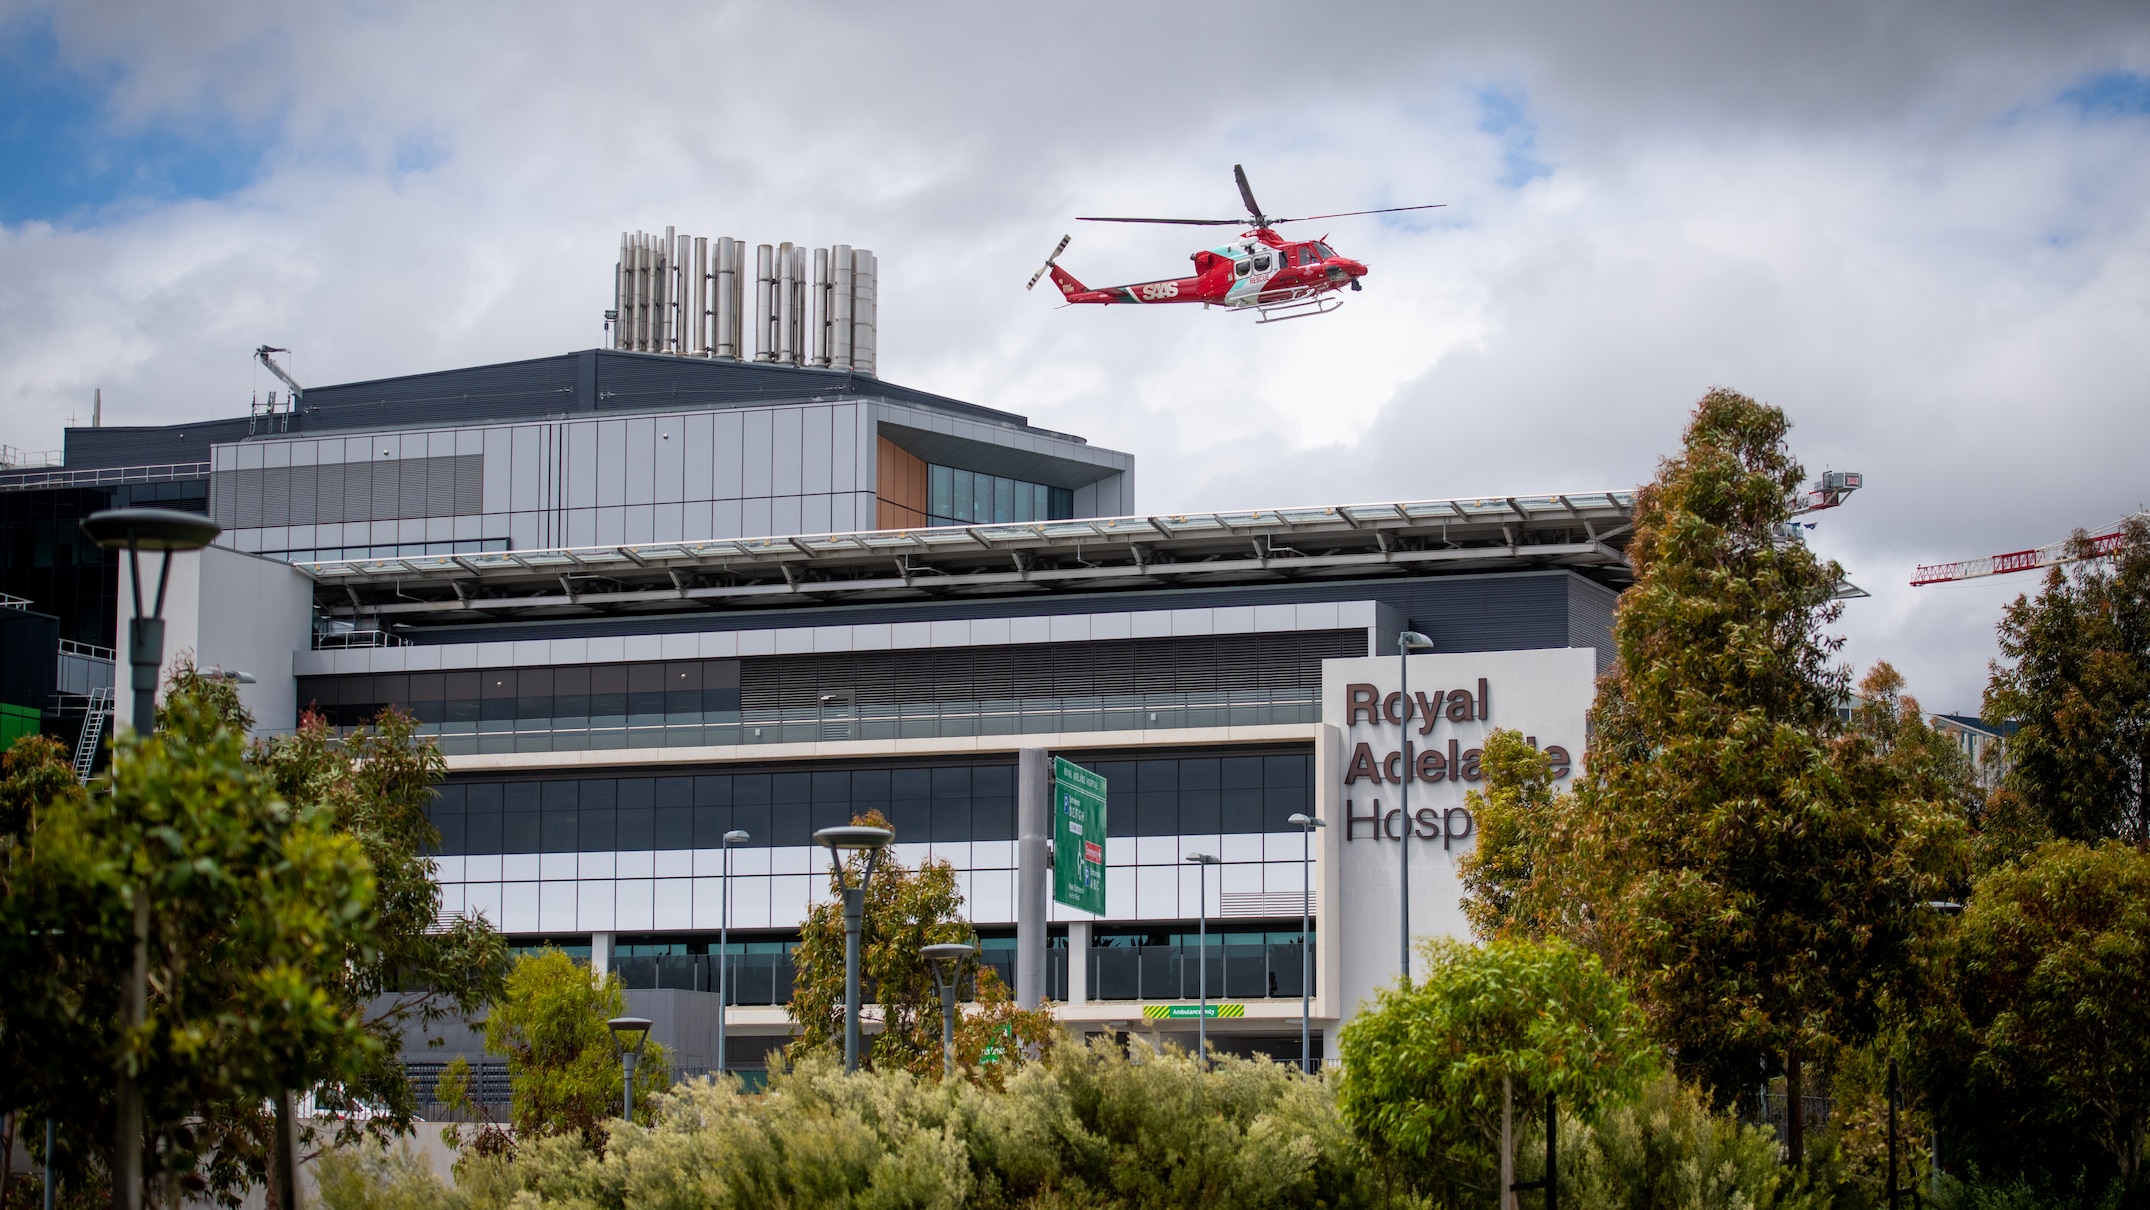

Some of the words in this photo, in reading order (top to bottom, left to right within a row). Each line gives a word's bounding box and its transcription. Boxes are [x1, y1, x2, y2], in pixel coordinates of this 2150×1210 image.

[1142, 281, 1179, 300] SAAS
[1249, 273, 1270, 284] RESCUE
[1346, 678, 1488, 735] Royal
[1344, 735, 1571, 785] Adelae
[1346, 798, 1473, 851] Hosp
